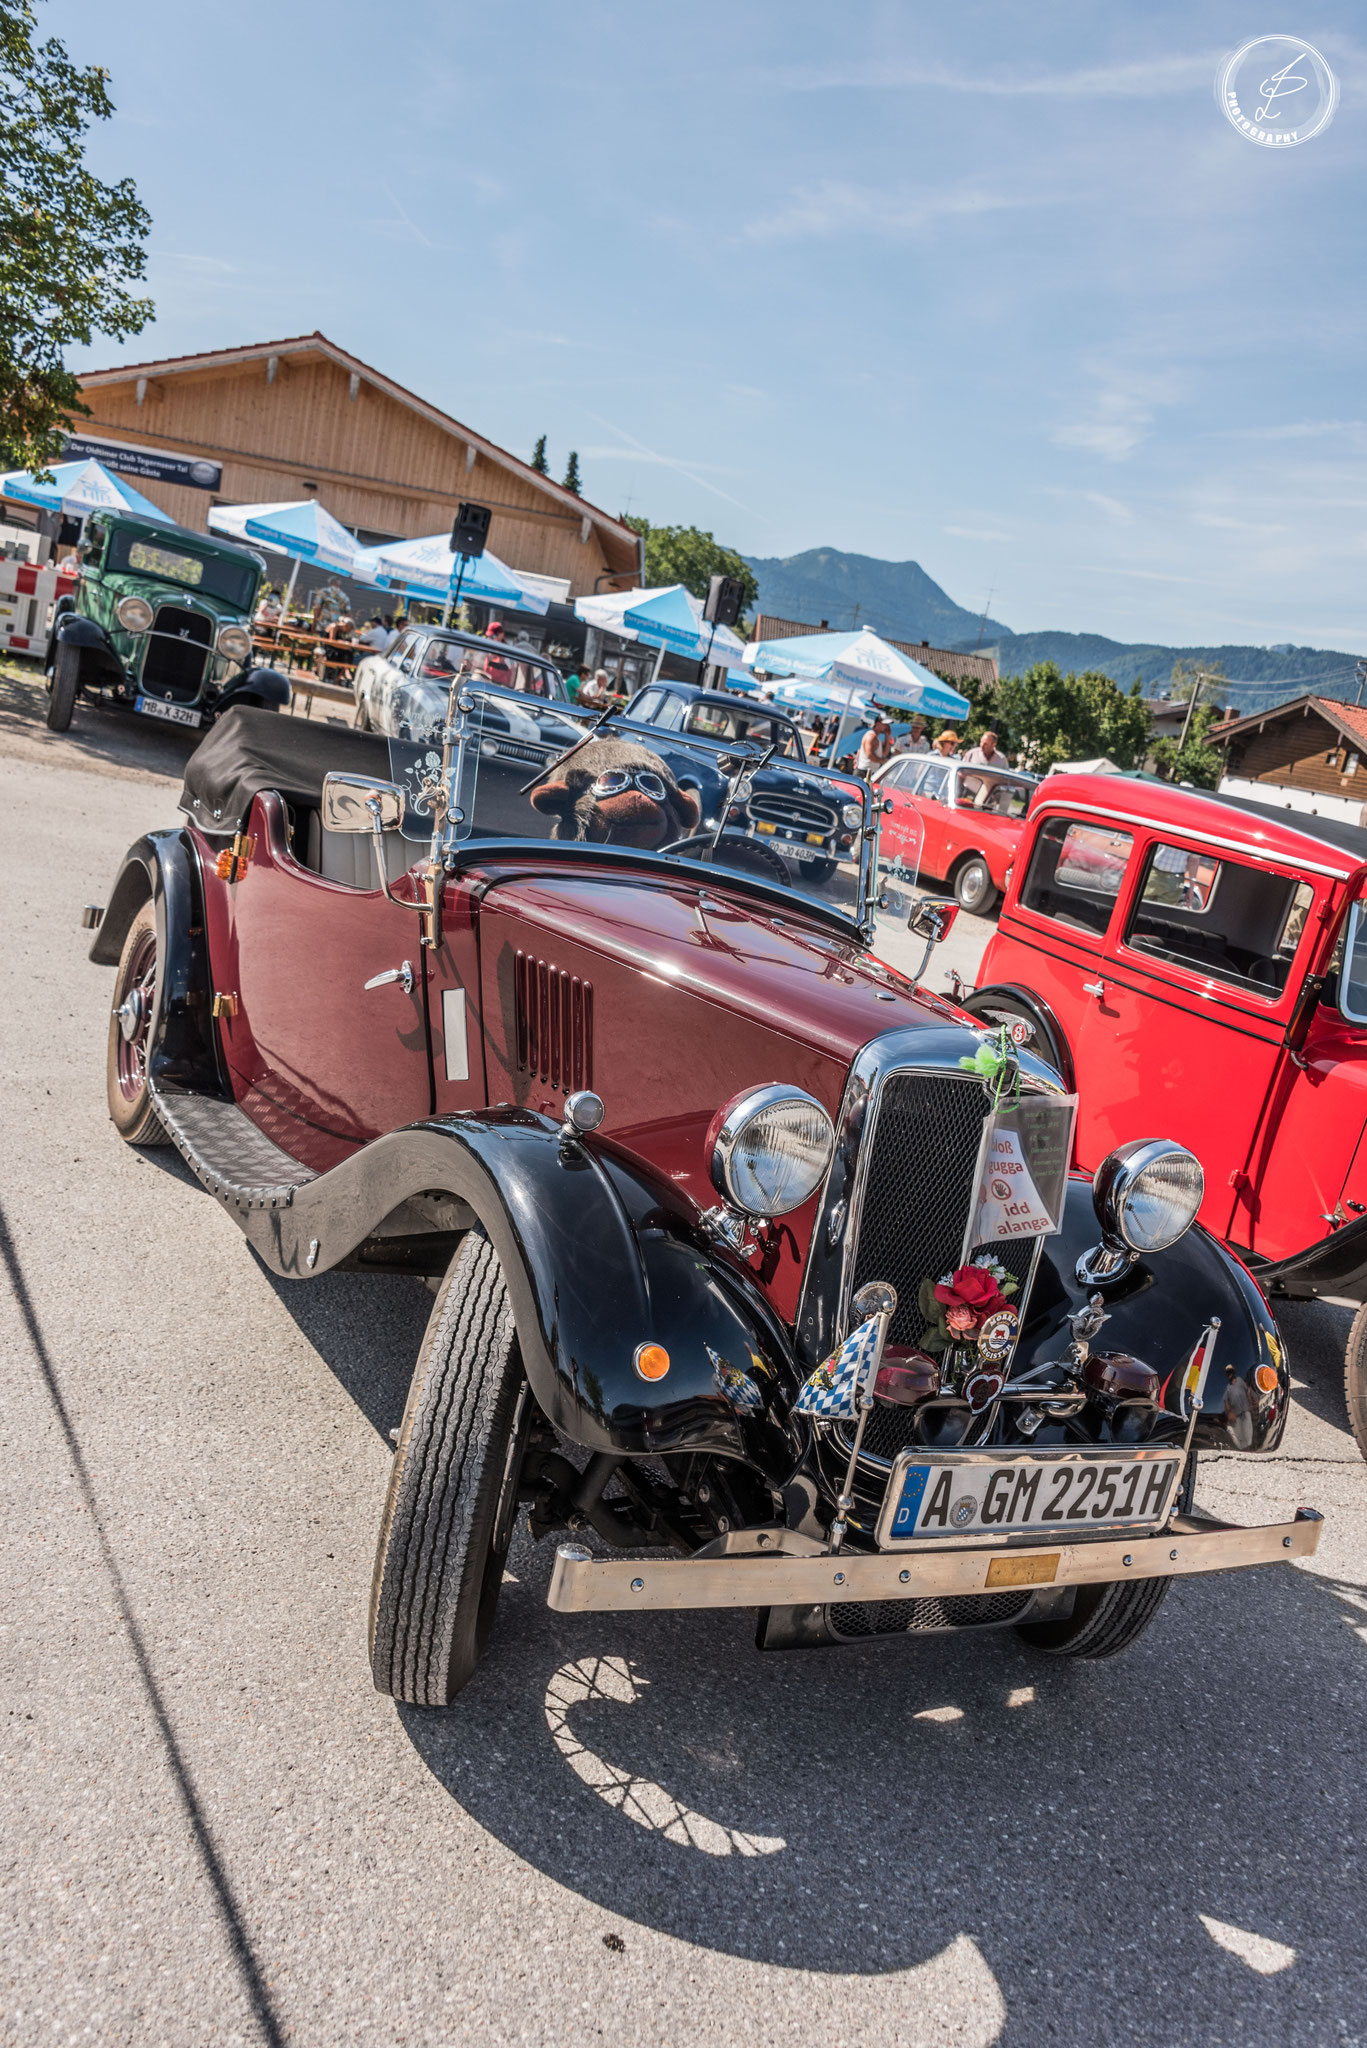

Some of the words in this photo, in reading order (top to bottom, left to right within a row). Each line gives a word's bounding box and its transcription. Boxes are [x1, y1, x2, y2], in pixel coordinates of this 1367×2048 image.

[70, 443, 85, 452] Der
[85, 446, 118, 460] Oldtimer
[118, 453, 136, 464] Club
[136, 456, 176, 471] Tegernseer
[176, 463, 188, 473] Tal
[139, 466, 161, 477] Gäste
[143, 700, 158, 713] MB
[163, 706, 171, 717] X
[172, 708, 194, 723] 32H
[794, 849, 816, 861] 403H
[1013, 1025, 1023, 1041] 8
[988, 1160, 1024, 1175] gugga
[1003, 1201, 1031, 1217] idd
[997, 1217, 1050, 1235] alanga
[989, 1313, 1018, 1328] MORRIS
[980, 1342, 1013, 1359] REGISTER
[920, 1470, 953, 1527] A
[980, 1468, 1043, 1525] GM
[1041, 1463, 1173, 1521] 2251H
[897, 1507, 910, 1524] D
